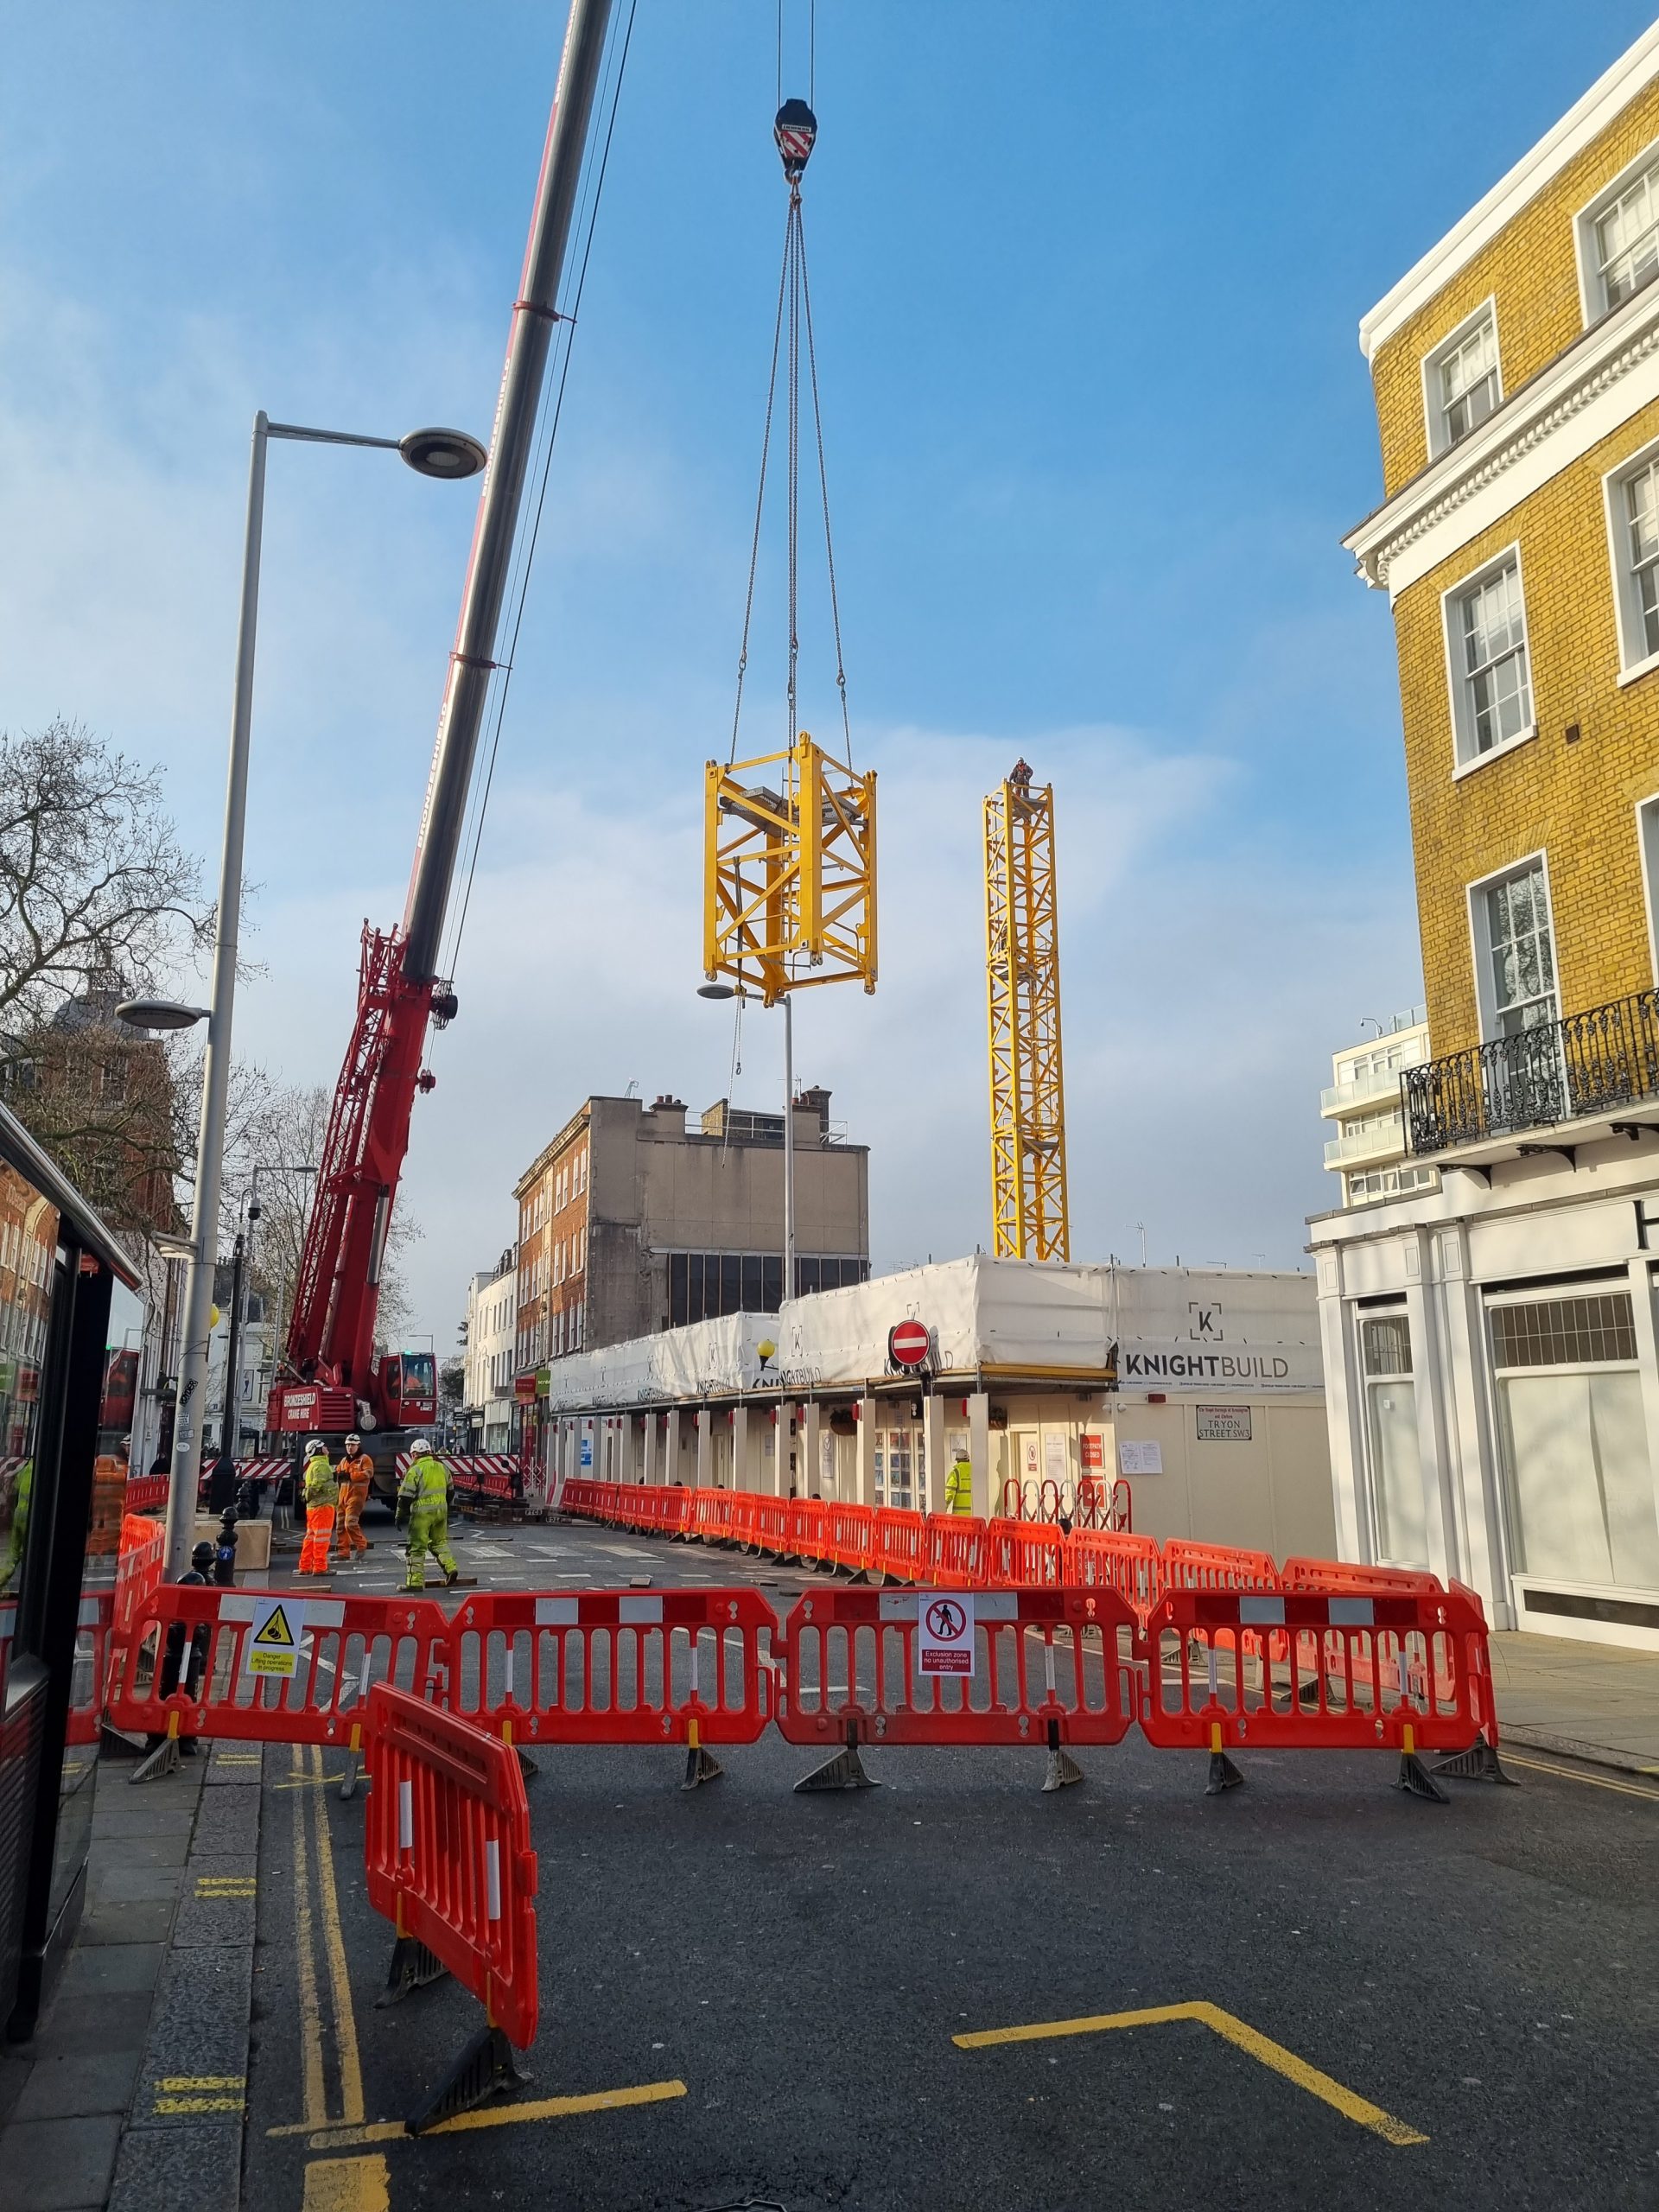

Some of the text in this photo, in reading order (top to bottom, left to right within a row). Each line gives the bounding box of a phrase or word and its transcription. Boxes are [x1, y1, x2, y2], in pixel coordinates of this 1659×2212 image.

[1198, 1311, 1214, 1332] K
[1125, 1353, 1288, 1378] KNIGHTBUILD
[1208, 1420, 1240, 1428] TRYON
